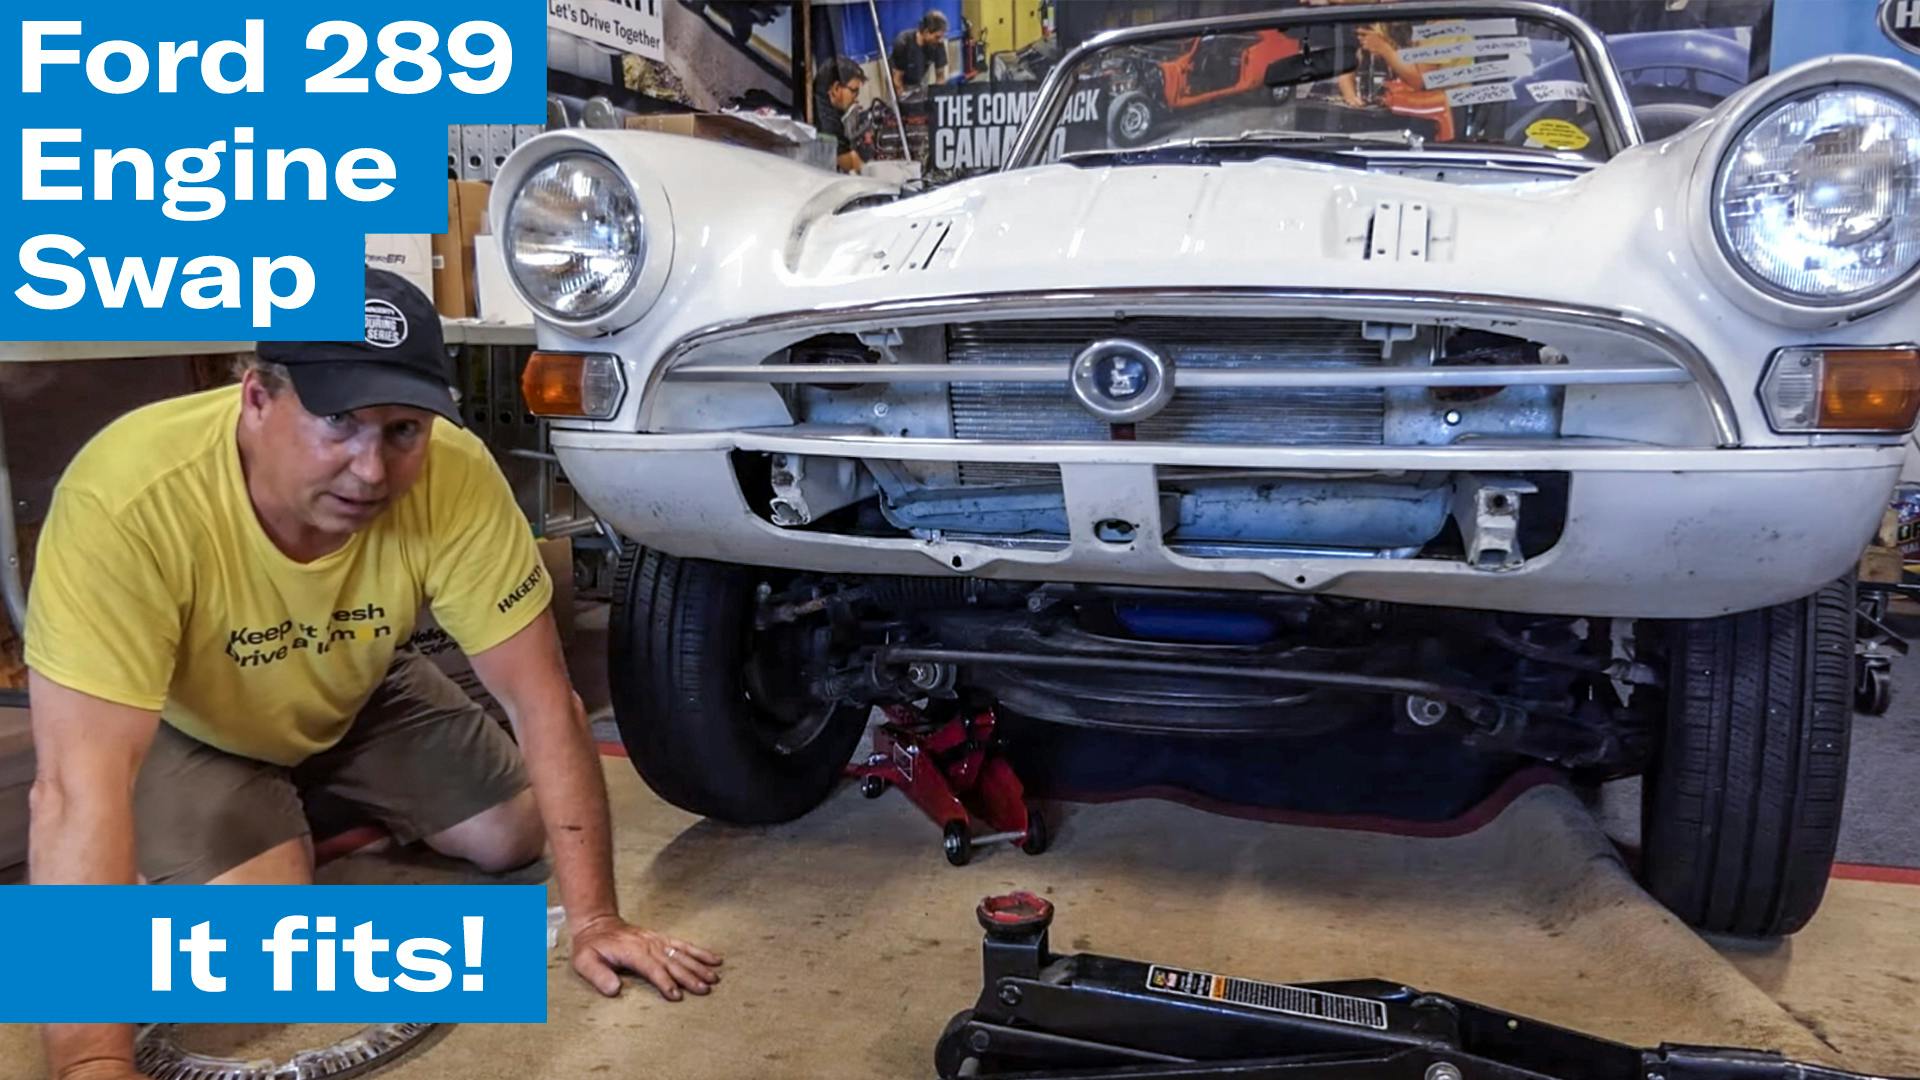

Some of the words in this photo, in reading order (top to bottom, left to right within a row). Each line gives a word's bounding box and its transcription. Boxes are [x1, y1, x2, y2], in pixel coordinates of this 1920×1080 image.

[549, 0, 578, 22] Let's
[580, 8, 611, 34] Drive
[613, 20, 660, 49] Together
[935, 95, 973, 126] THE
[935, 126, 1066, 170] CAMAO
[230, 619, 293, 645] Keep
